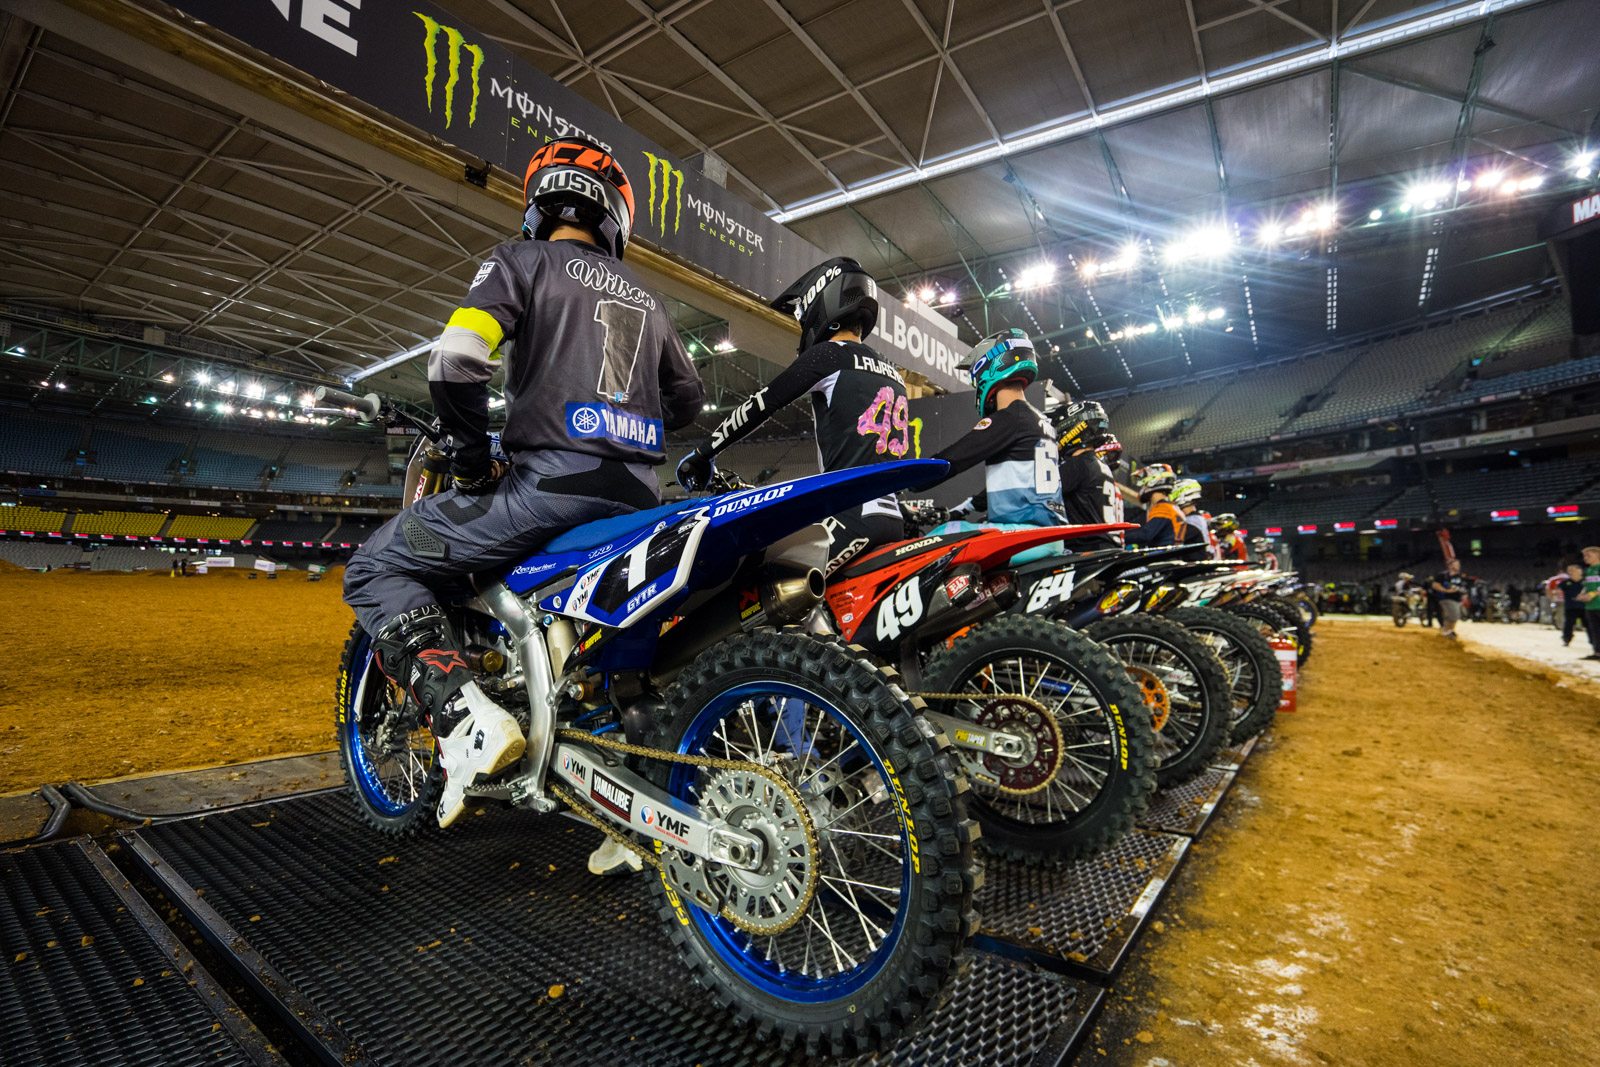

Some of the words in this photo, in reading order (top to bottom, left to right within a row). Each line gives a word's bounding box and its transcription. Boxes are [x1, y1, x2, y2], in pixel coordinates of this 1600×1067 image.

[687, 193, 764, 252] MONSTER
[699, 222, 754, 257] ENERGY
[565, 258, 655, 311] Wilson
[802, 266, 842, 311] 100%
[594, 301, 646, 401] 1
[871, 307, 971, 386] LBOURNE
[601, 408, 657, 446] YAMAHA
[711, 386, 769, 449] SHIFT
[856, 386, 909, 459] 49
[1060, 420, 1088, 447] PENRITE
[712, 484, 794, 519] DUNLOP
[895, 536, 944, 556] HONDA
[627, 582, 658, 613] GYTR
[876, 575, 924, 642] 49
[1026, 570, 1077, 613] 64
[339, 670, 348, 723] DUNLOP
[1109, 703, 1128, 770] DUNLOP
[593, 774, 631, 813] YAMALUBE
[883, 758, 921, 874] DUNLOP
[656, 810, 690, 838] YMF
